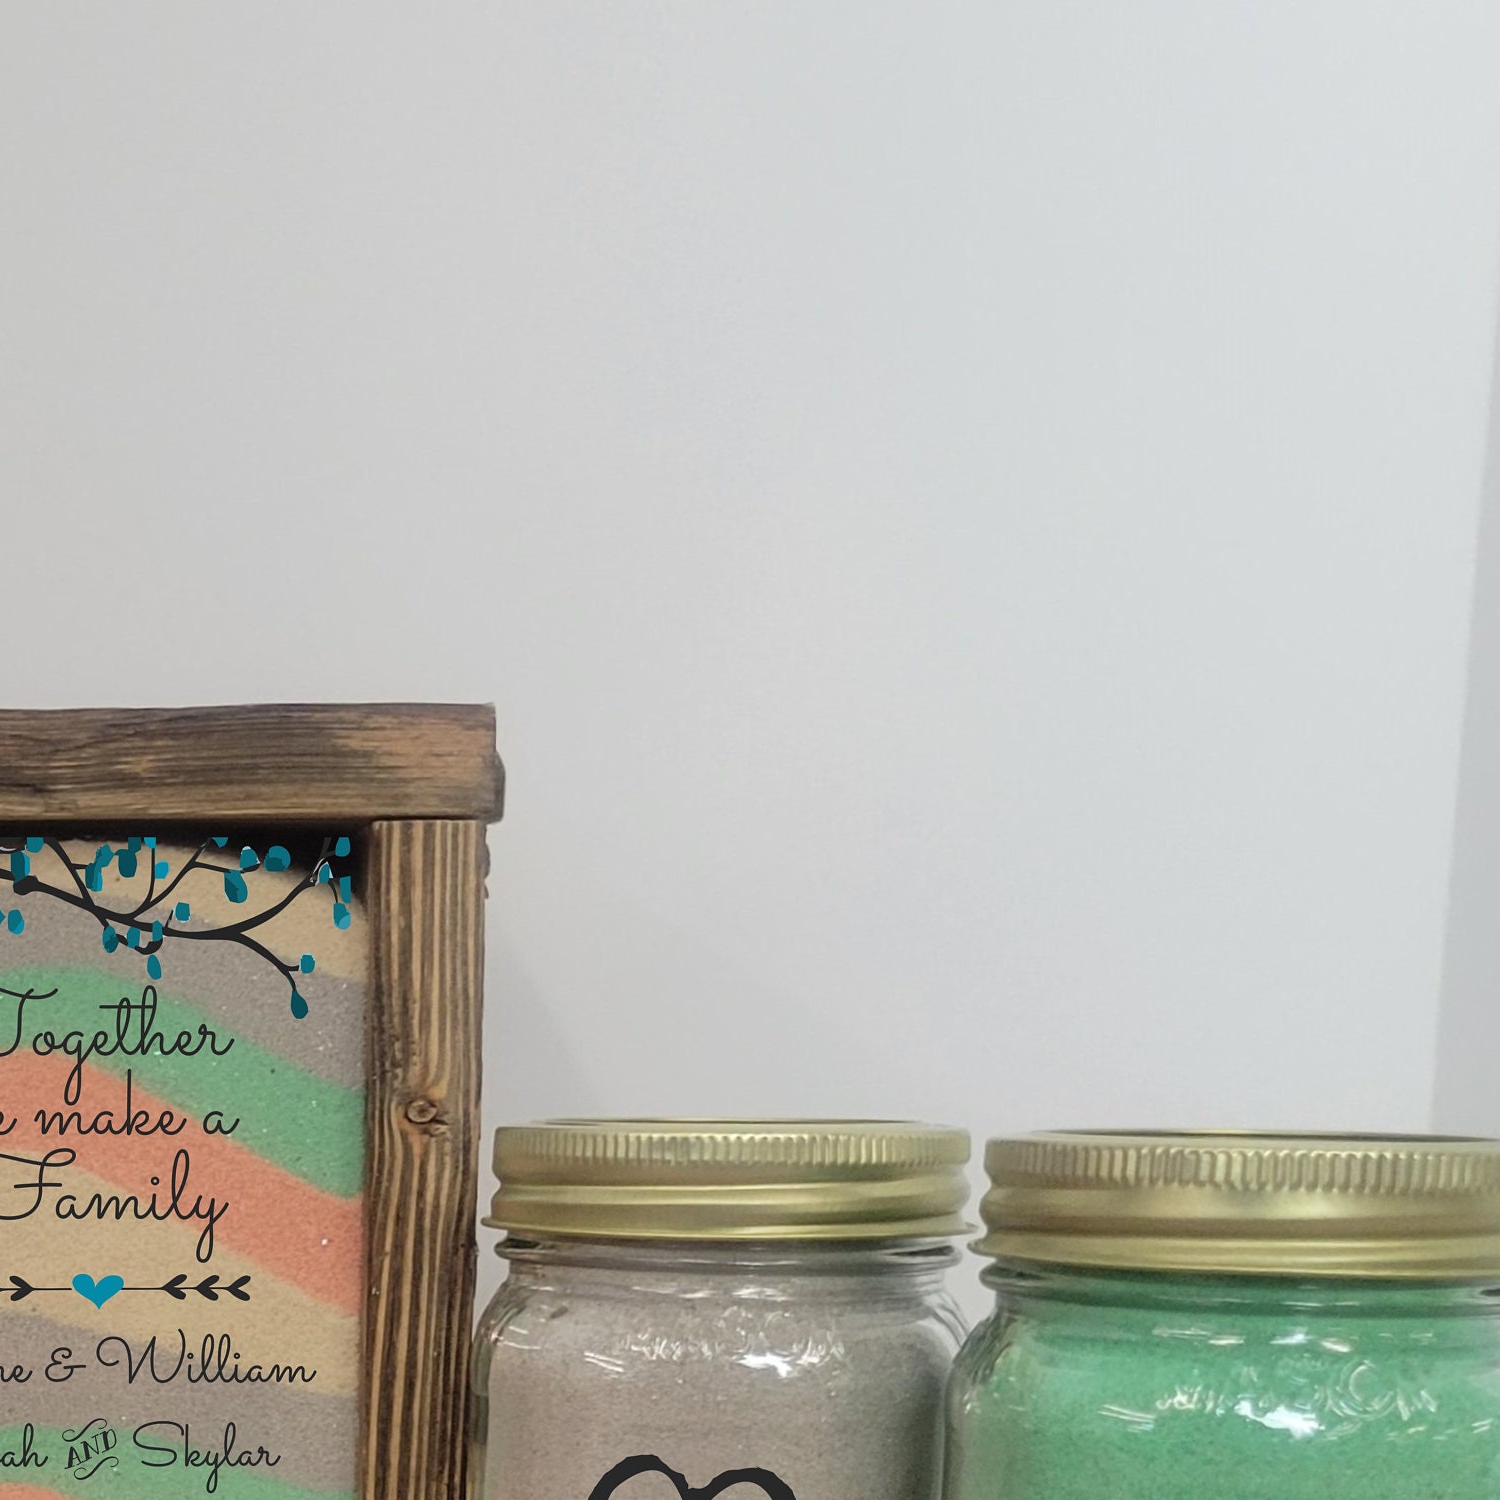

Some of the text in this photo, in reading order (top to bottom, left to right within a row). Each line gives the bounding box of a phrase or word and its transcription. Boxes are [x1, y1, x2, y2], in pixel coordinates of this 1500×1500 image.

[34, 1068, 187, 1135] make
[202, 1109, 240, 1135] a
[44, 1347, 86, 1382] &
[96, 1328, 317, 1385] William
[63, 1423, 119, 1473] AND
[132, 1420, 281, 1493] Skylar
